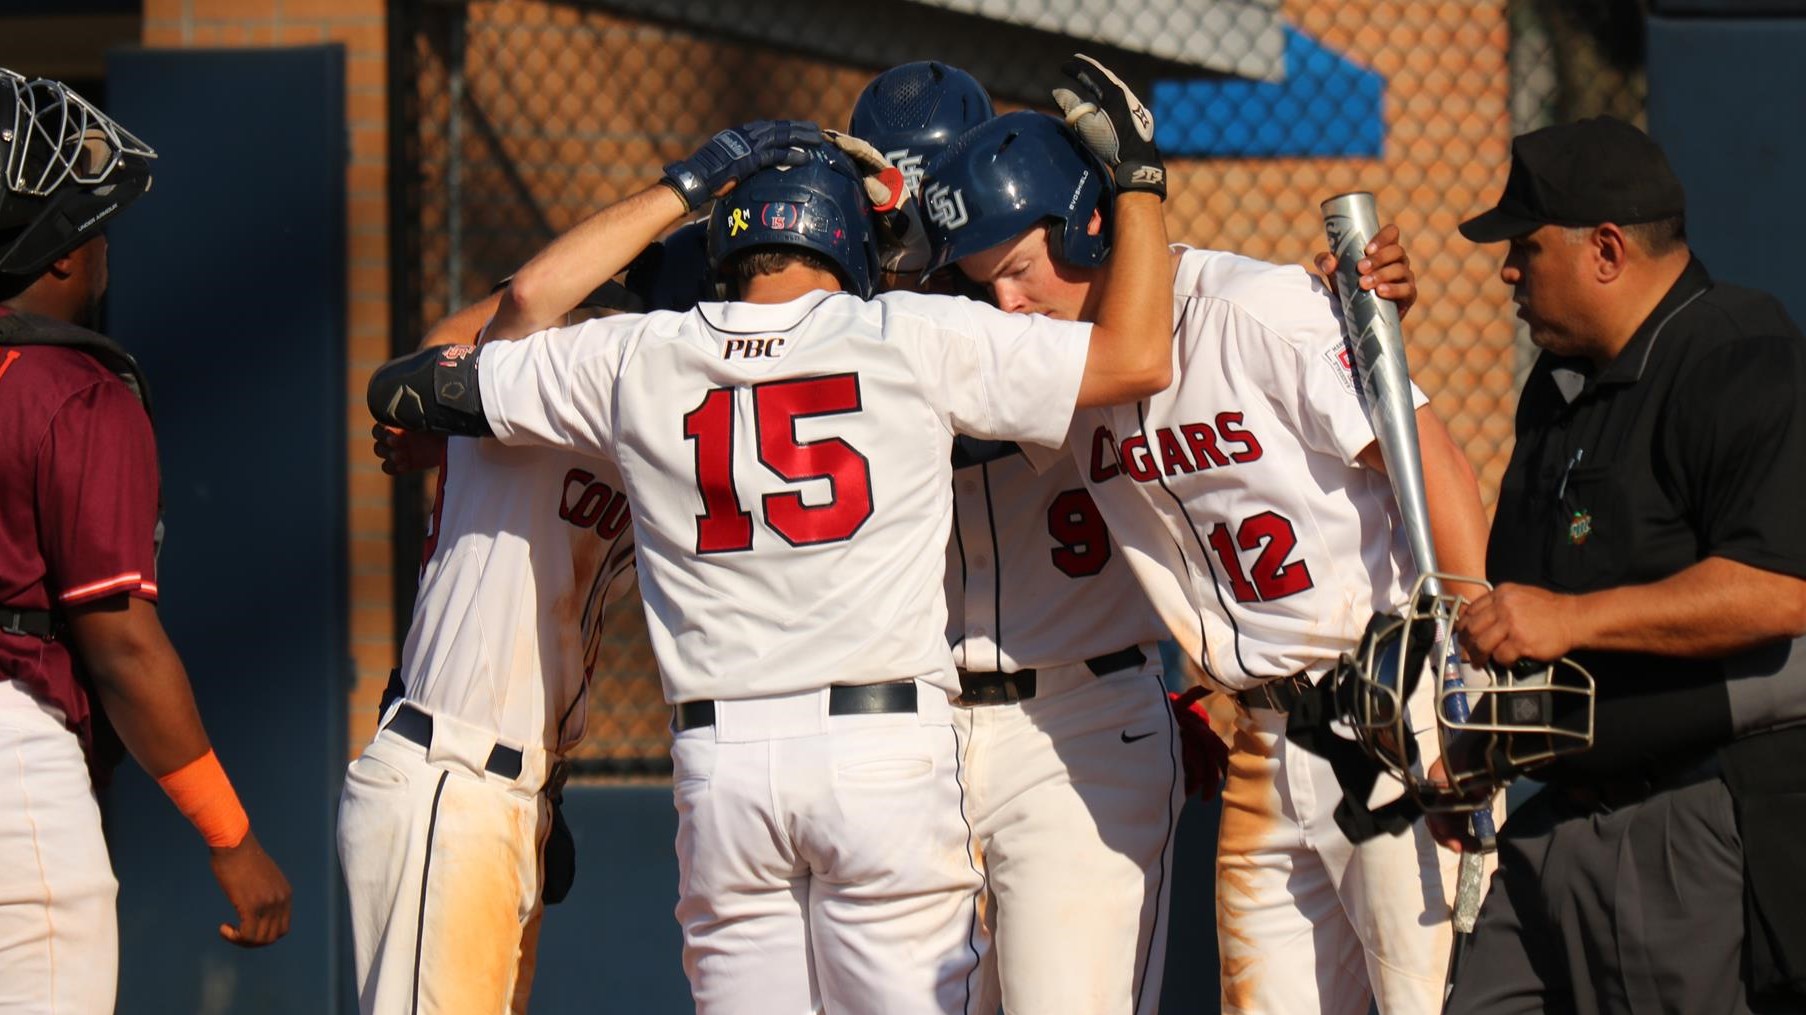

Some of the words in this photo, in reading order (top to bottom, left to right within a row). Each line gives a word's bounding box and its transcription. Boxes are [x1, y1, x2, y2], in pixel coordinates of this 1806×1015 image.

[77, 216, 96, 232] UNDER
[96, 202, 119, 220] ARMOUR
[727, 215, 734, 228] R
[742, 208, 751, 220] M
[924, 182, 969, 230] CSU
[723, 338, 785, 360] PBC
[683, 371, 875, 555] 15
[1089, 411, 1263, 483] CGARS
[1047, 488, 1111, 578] 9
[1207, 510, 1314, 603] 12
